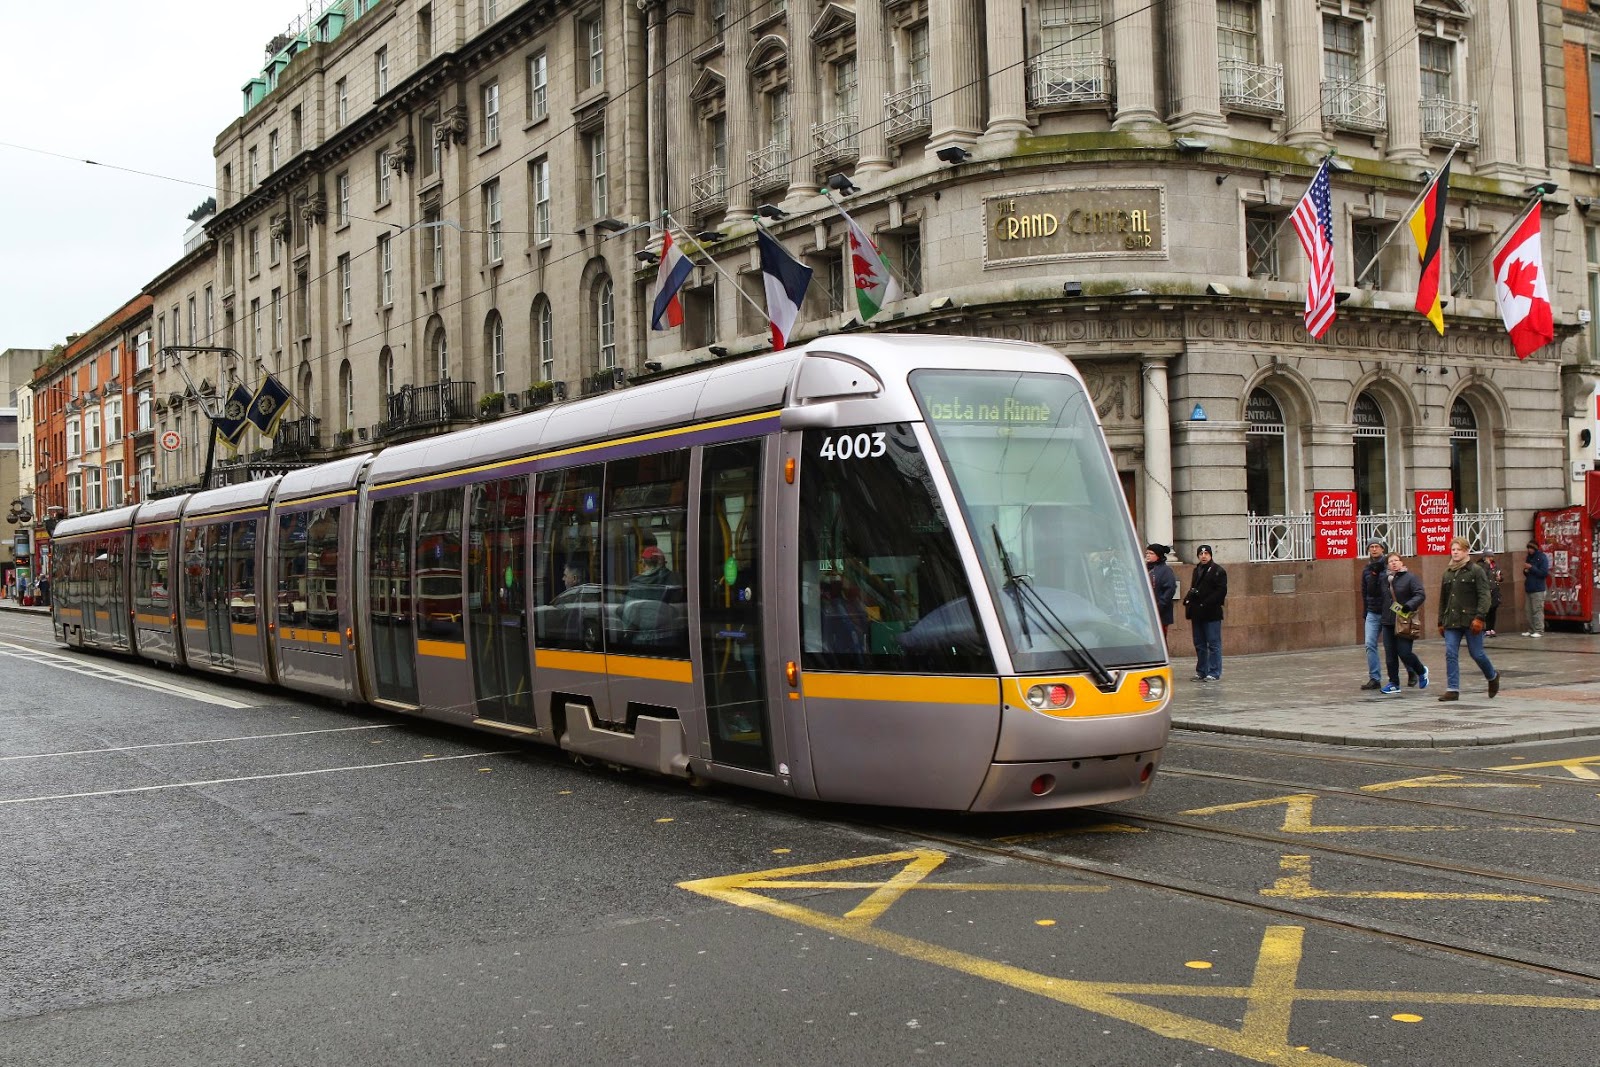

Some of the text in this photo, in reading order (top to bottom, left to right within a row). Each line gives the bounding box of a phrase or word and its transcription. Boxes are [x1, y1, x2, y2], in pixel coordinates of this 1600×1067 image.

[995, 208, 1151, 241] GRAND CENTRAL
[979, 404, 999, 420] na
[819, 432, 887, 461] 4003
[1321, 494, 1350, 508] Grand
[1421, 493, 1448, 506] Grand
[1319, 503, 1353, 517] Central
[1419, 502, 1450, 515] Central
[1320, 527, 1353, 536] Great Food
[1421, 525, 1450, 534] Great Food
[1327, 537, 1348, 546] Served
[1427, 534, 1446, 542] Served
[1327, 547, 1347, 556] 7 Days
[1427, 543, 1446, 552] 7 Days
